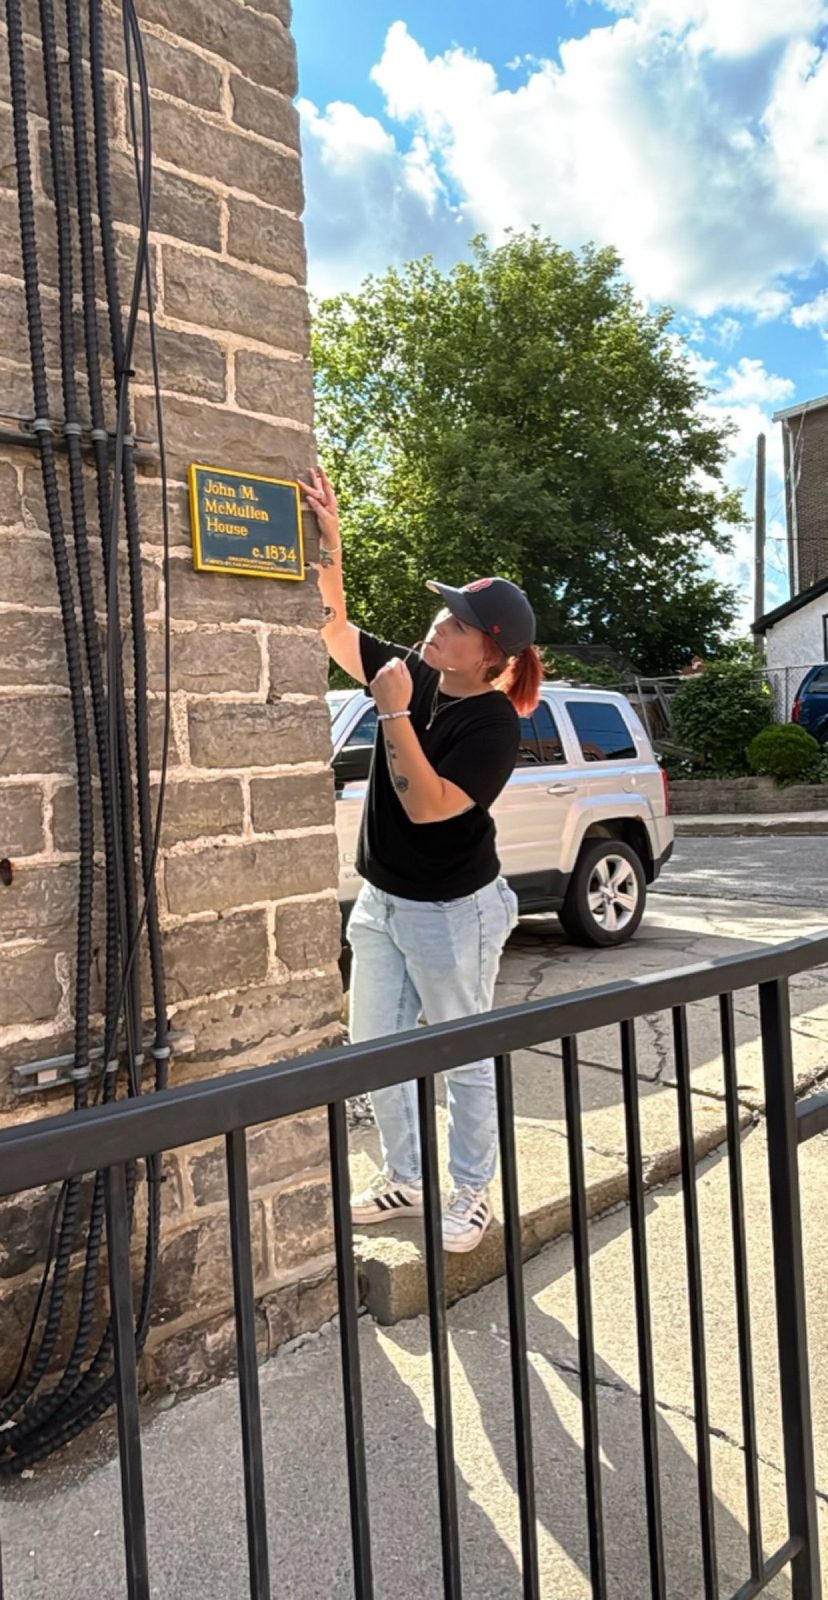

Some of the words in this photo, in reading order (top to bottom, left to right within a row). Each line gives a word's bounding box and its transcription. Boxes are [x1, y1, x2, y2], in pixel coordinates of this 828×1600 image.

[204, 479, 236, 498] John
[240, 484, 259, 501] M.
[204, 497, 269, 522] McMullen
[205, 516, 248, 536] House
[252, 545, 296, 562] c.1834
